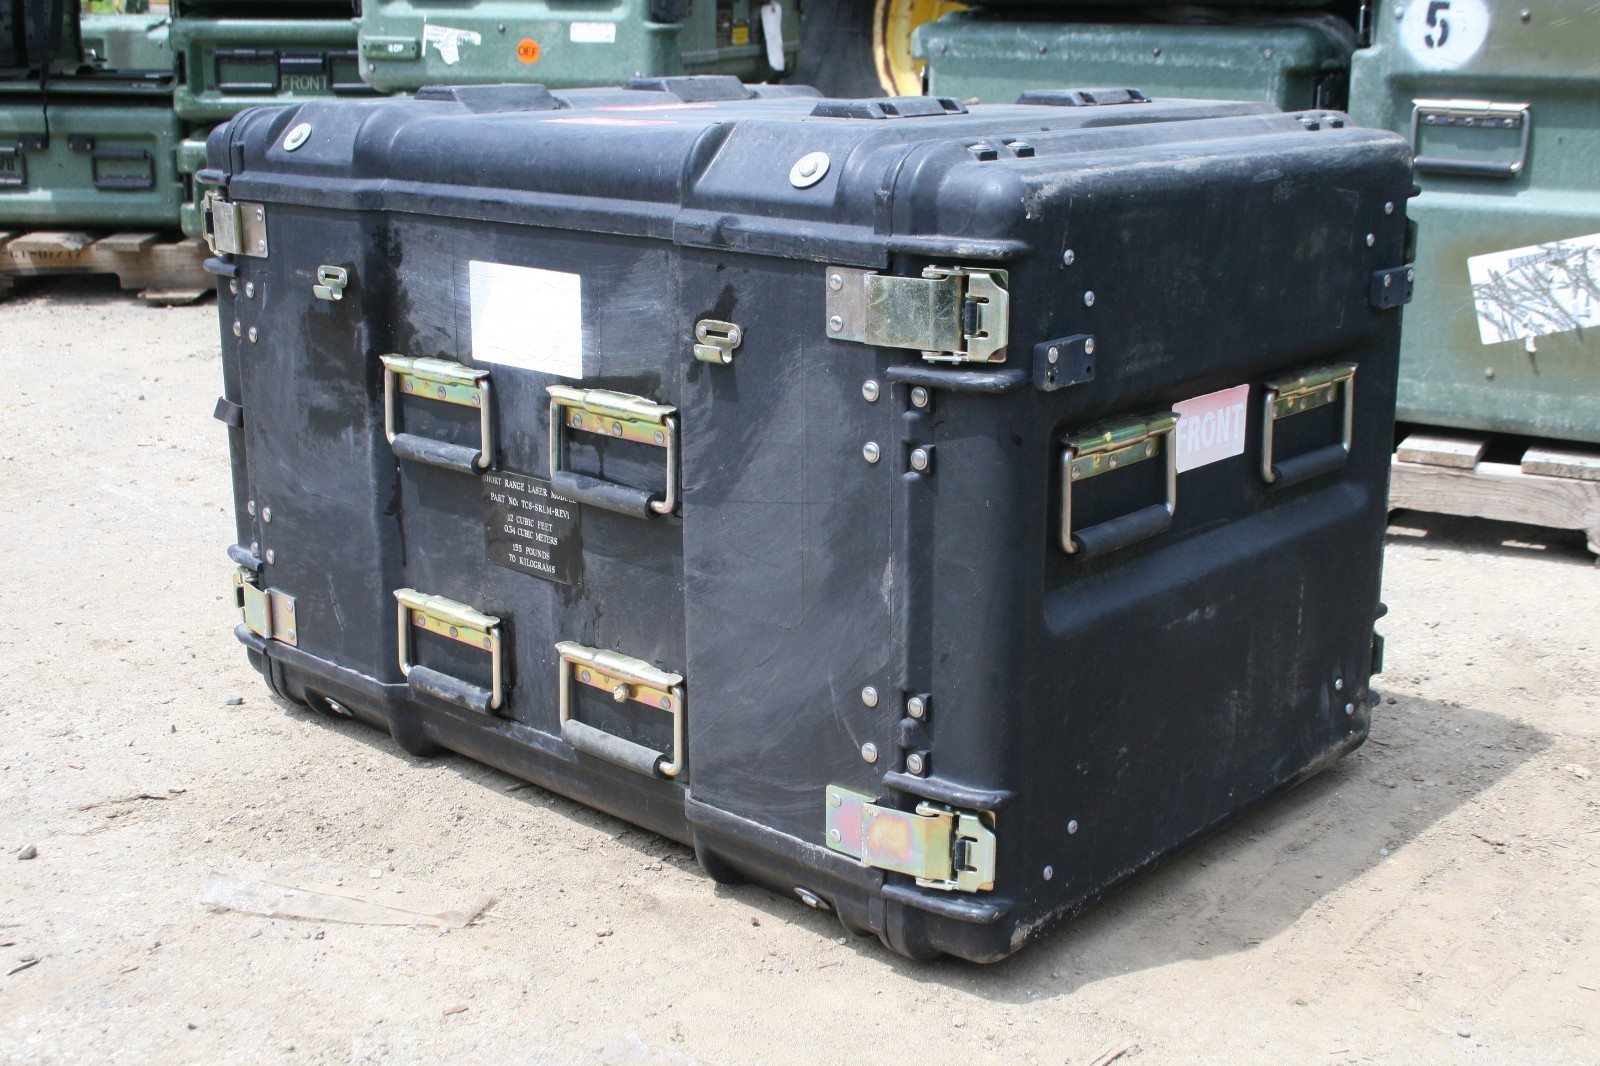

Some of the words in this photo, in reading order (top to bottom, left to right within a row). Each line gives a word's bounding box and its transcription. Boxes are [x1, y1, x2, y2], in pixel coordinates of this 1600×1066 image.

[1424, 1, 1450, 49] 5
[281, 74, 328, 91] FRONT
[1176, 403, 1244, 456] FRONT
[504, 479, 525, 492] RANGE
[528, 484, 548, 497] LASER
[490, 492, 506, 504] PART
[507, 513, 514, 523] 12
[516, 515, 534, 528] CUBIC
[537, 521, 553, 533] FEET
[517, 527, 534, 540] CUBIC
[535, 532, 558, 546] METERS
[525, 546, 550, 561] POUNDS
[508, 553, 517, 563] 70
[519, 556, 556, 574] KILOGRAMS
